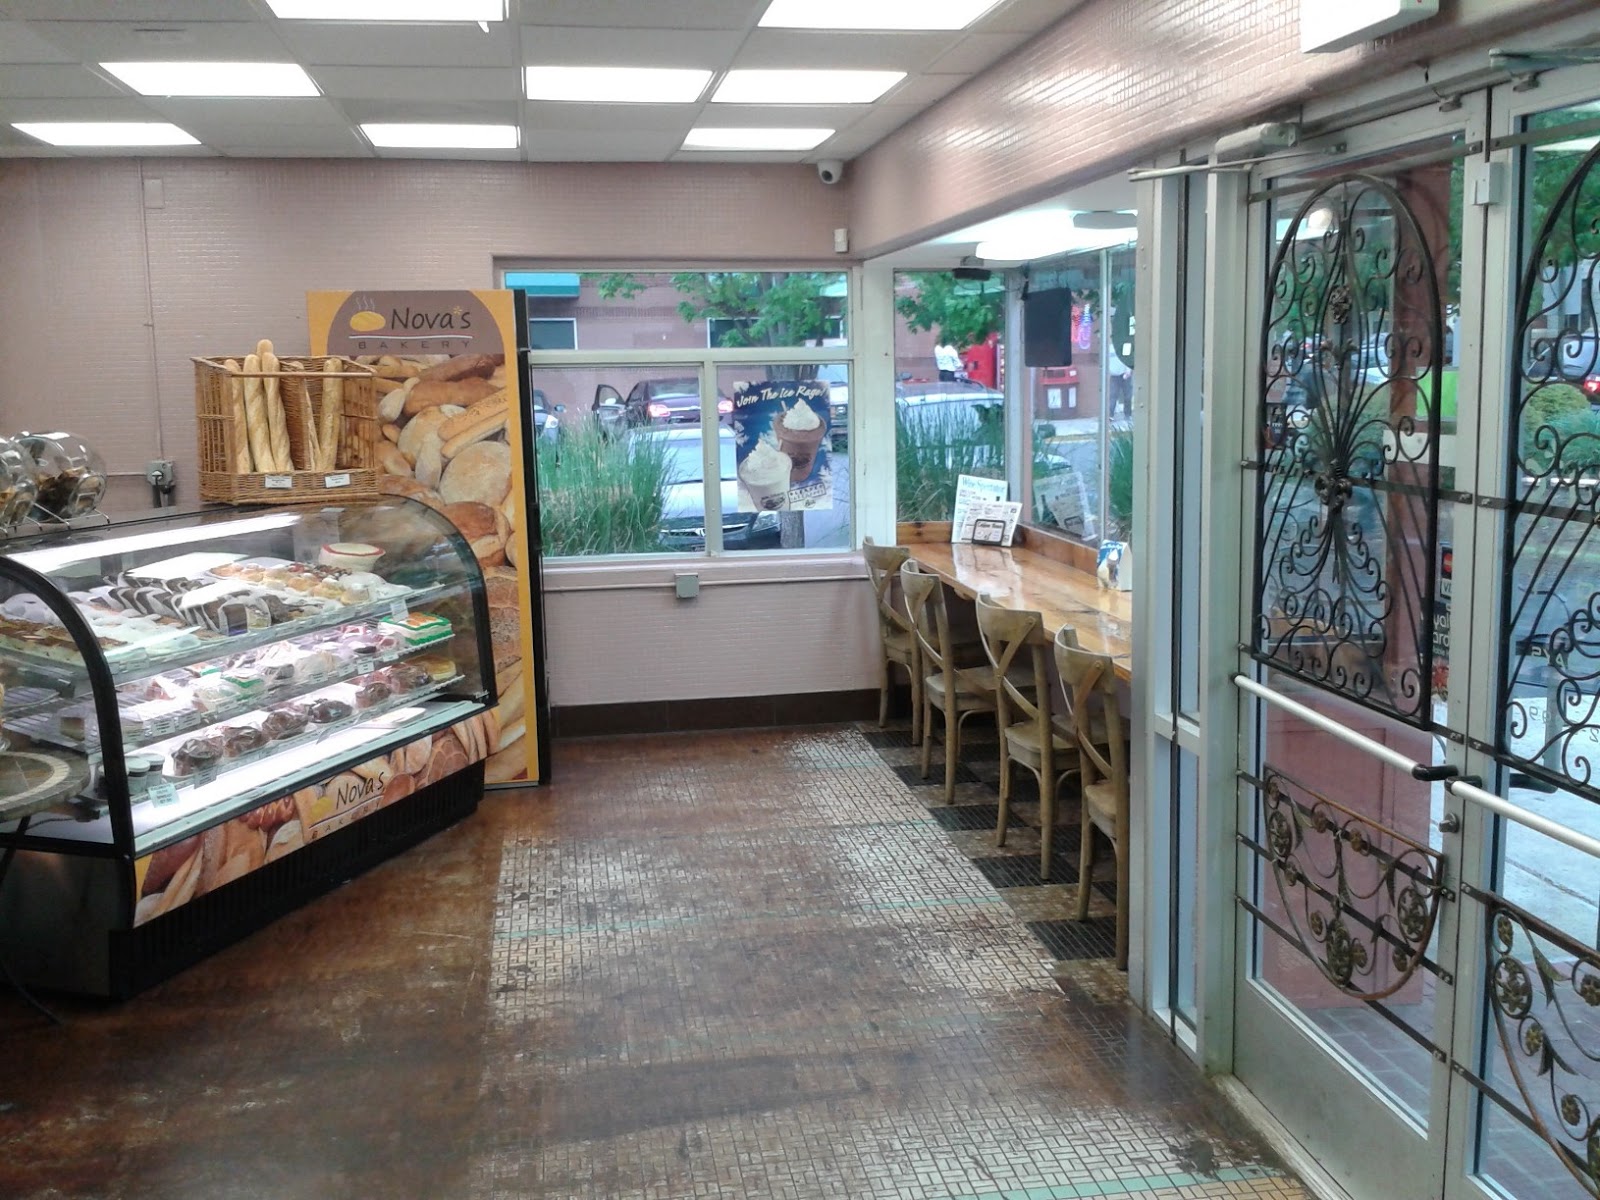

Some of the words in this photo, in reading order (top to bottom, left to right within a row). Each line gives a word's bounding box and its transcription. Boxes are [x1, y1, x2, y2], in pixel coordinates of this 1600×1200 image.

[391, 306, 471, 330] Nova's
[358, 341, 469, 350] BAKERY
[736, 395, 760, 408] Join
[761, 387, 779, 401] The
